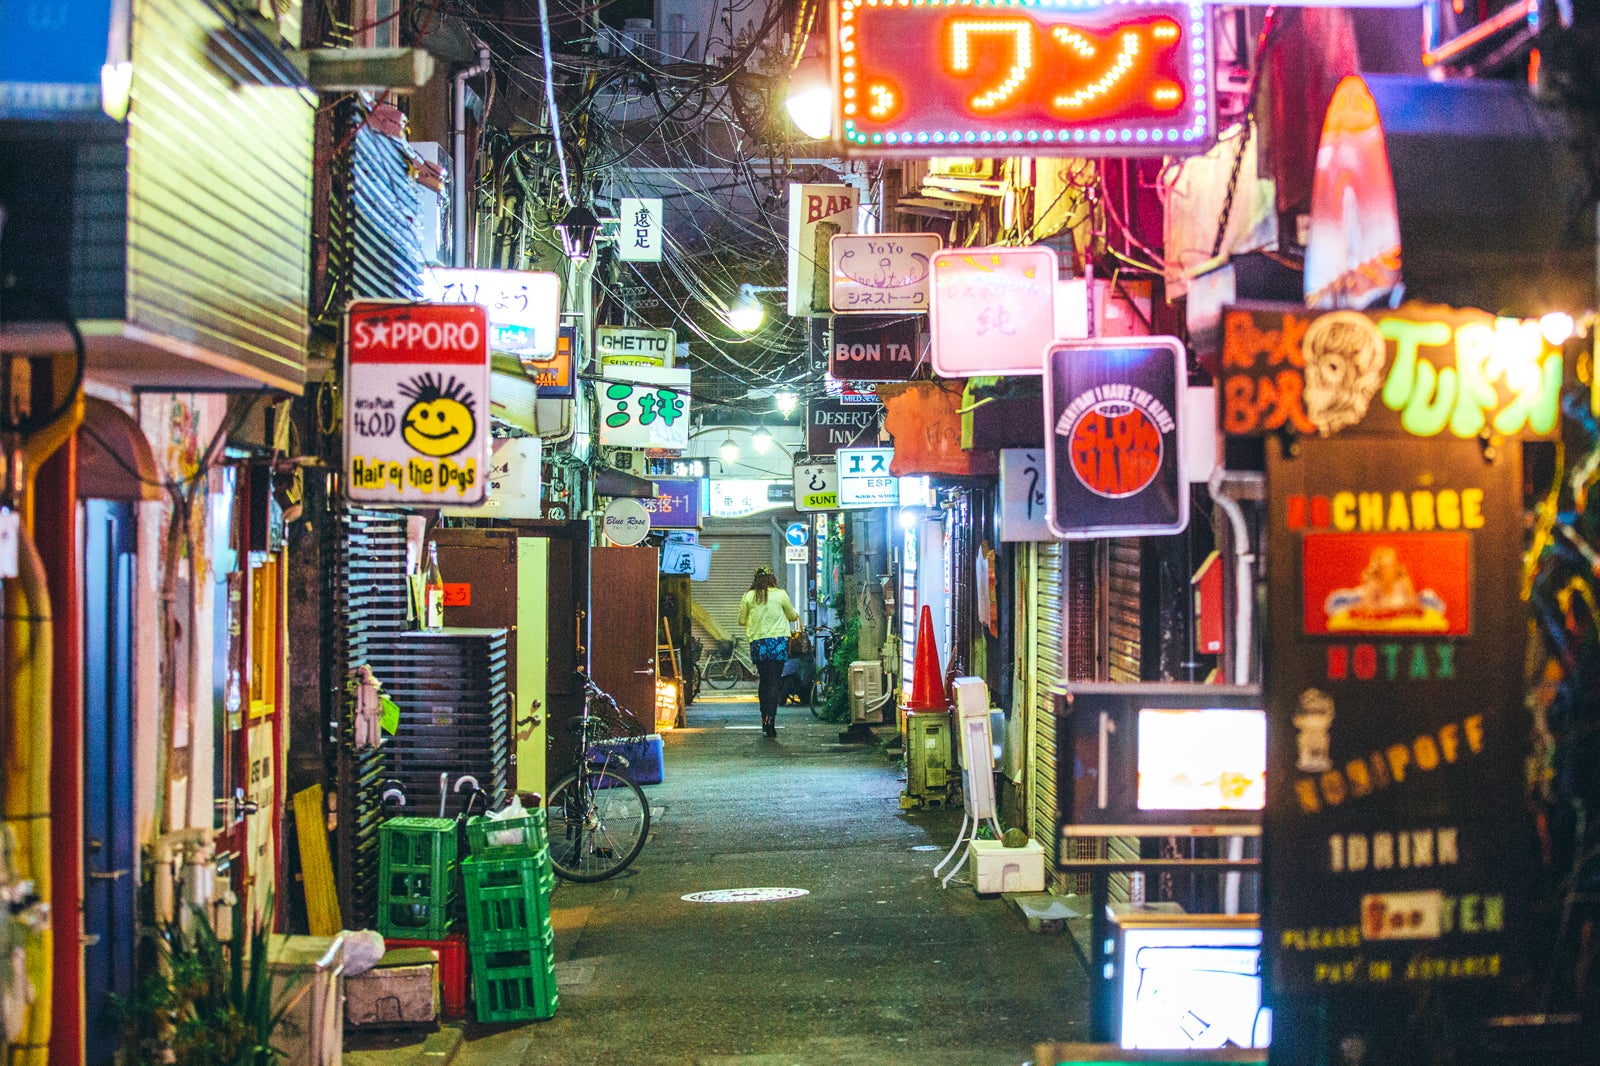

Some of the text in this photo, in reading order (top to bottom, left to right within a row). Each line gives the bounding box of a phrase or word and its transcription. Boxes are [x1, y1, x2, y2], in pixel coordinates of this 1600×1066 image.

[807, 195, 852, 225] BAR
[848, 291, 925, 305] シネストーク
[601, 335, 668, 352] GHETTO
[814, 410, 872, 429] DESERT
[828, 428, 855, 444] INN
[353, 459, 385, 487] Hair
[408, 460, 433, 486] the
[439, 461, 475, 492] Dogs
[867, 479, 892, 488] ESP
[810, 495, 837, 505] SUNT
[1332, 487, 1486, 532] CHARGE
[606, 515, 646, 526] Blue Rose
[1327, 643, 1454, 681] NO TAX
